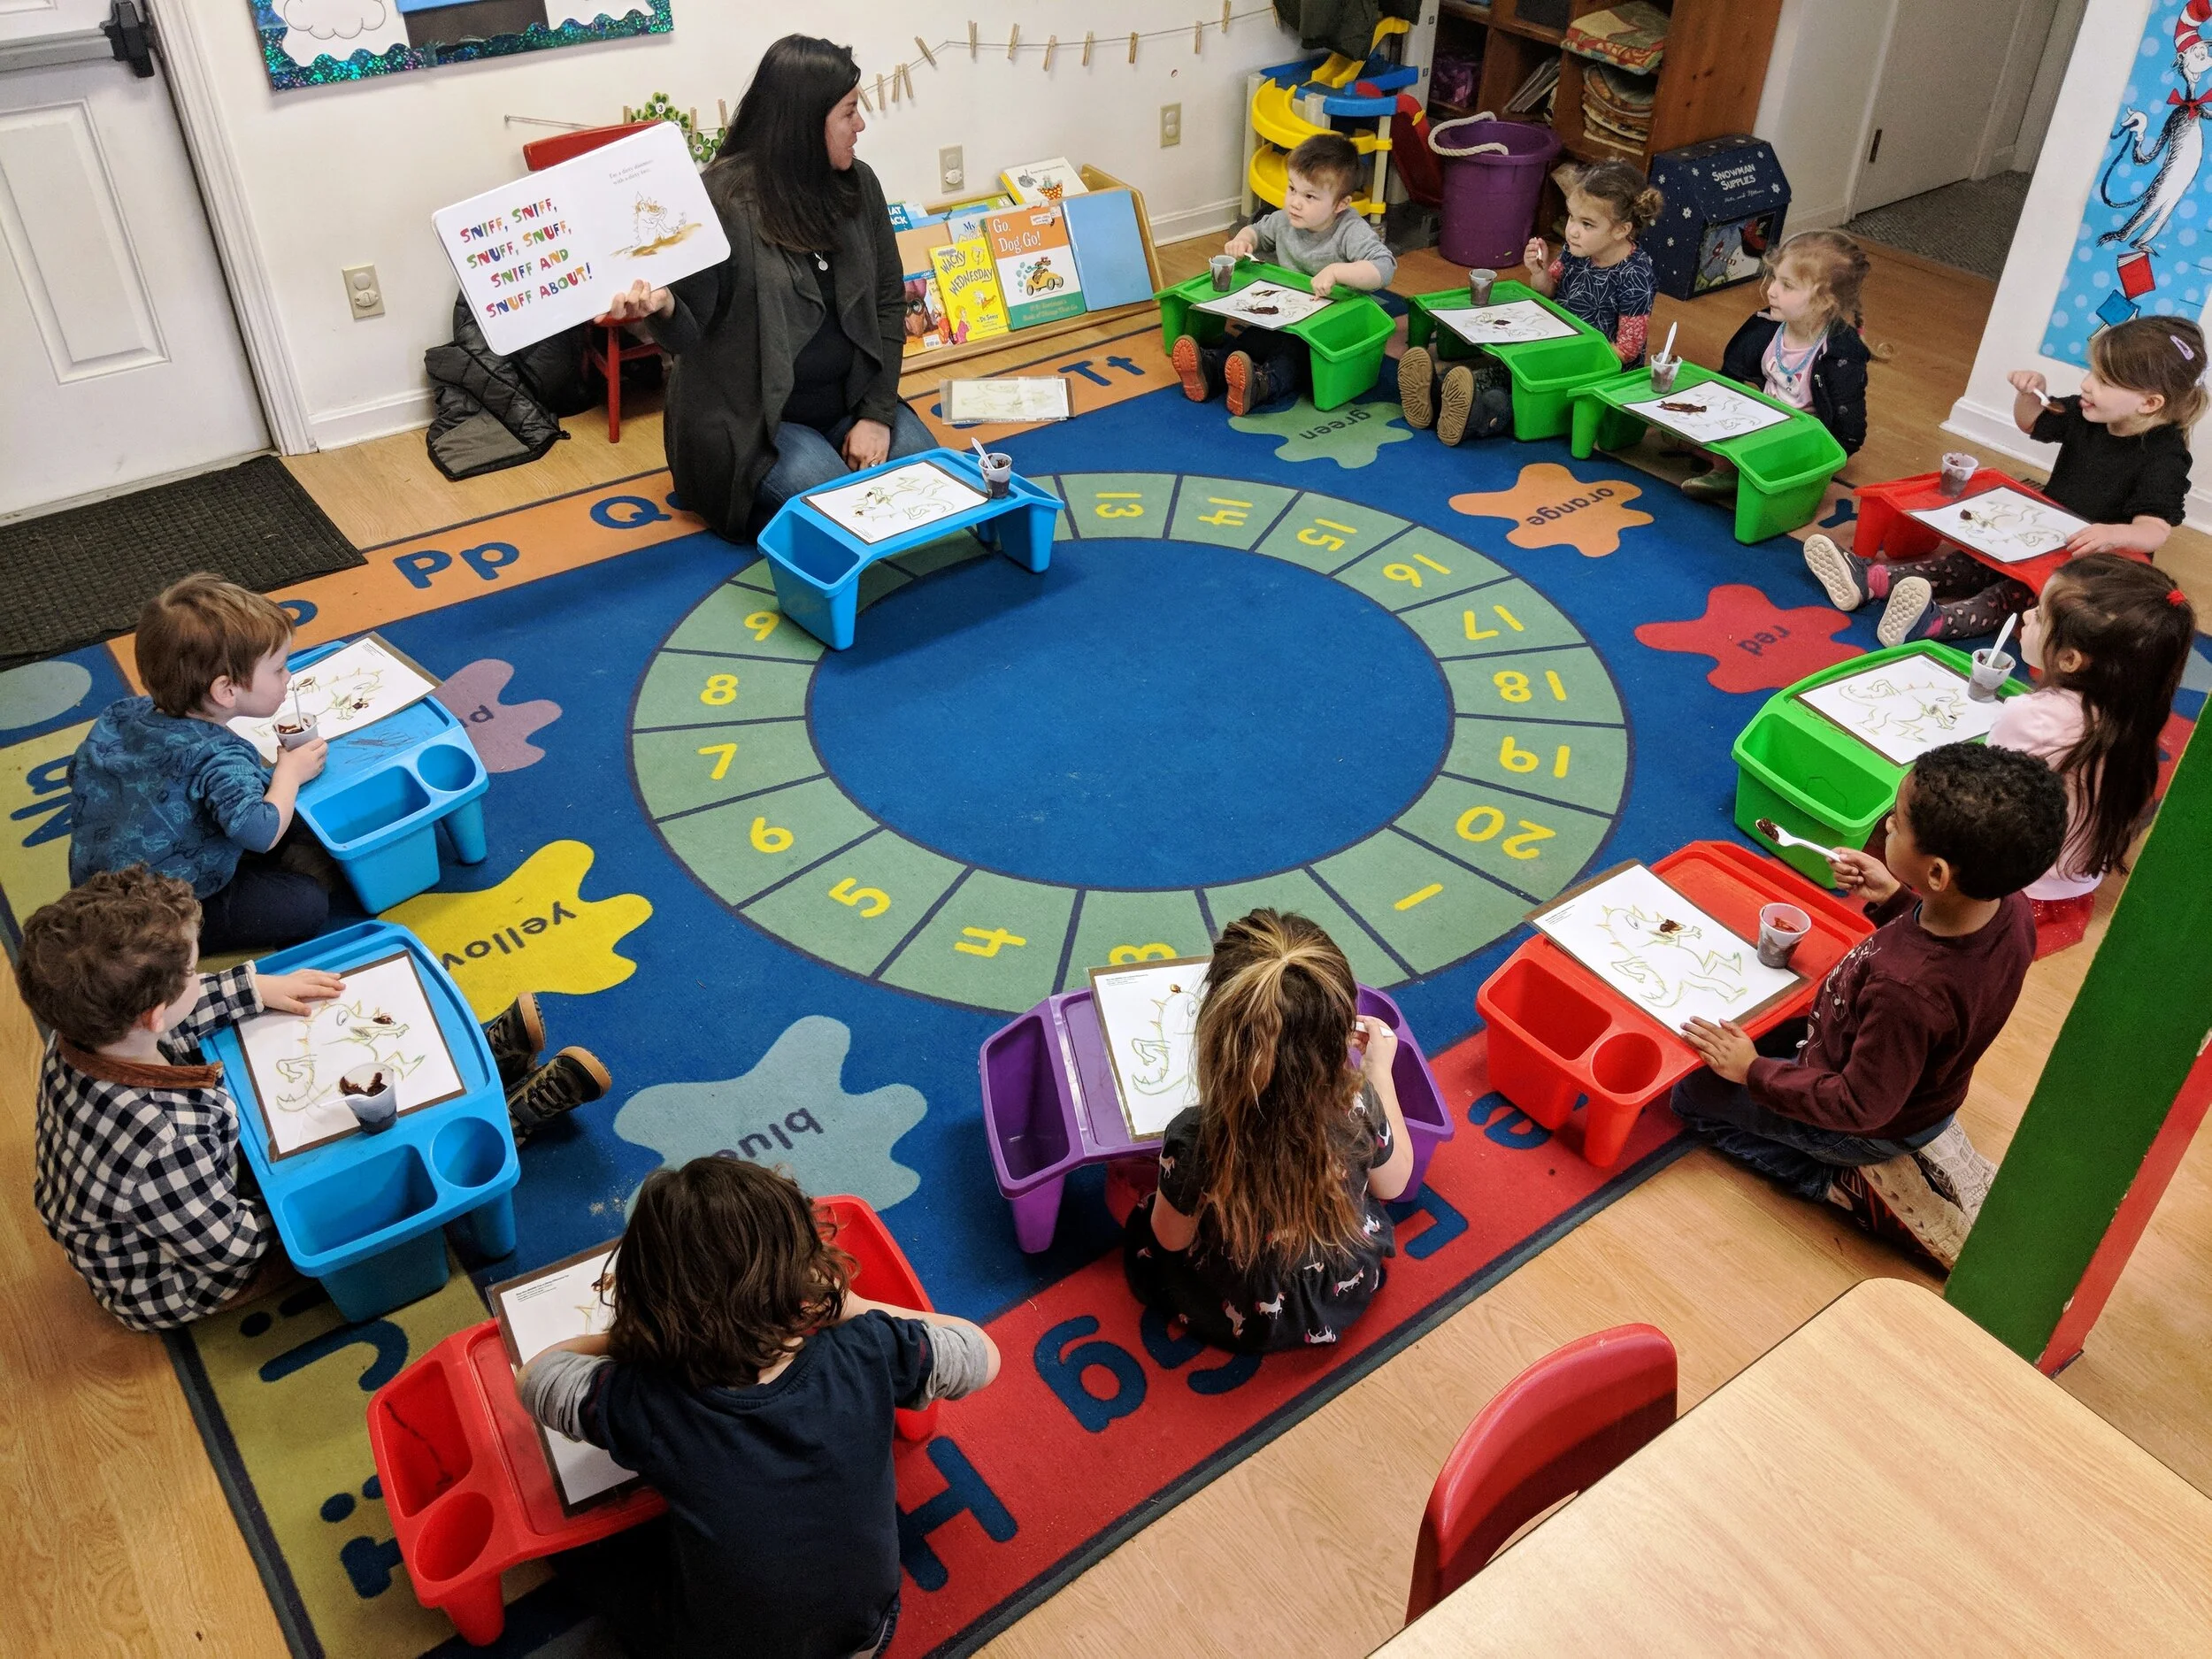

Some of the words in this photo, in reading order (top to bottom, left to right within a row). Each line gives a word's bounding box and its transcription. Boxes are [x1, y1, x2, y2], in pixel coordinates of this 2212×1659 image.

[1711, 164, 1755, 181] SNOWMAN
[1720, 174, 1756, 191] SUPPLIES
[459, 217, 509, 243] SNIFF,
[511, 198, 557, 223] SNIFF,
[466, 242, 519, 269] SNUFF,
[523, 220, 572, 248] SNUFF,
[1023, 230, 1041, 248] Go!
[490, 262, 533, 288] SNIFF
[540, 249, 569, 271] AND
[941, 250, 966, 274] WACKY
[486, 290, 532, 318] SNUFF
[539, 262, 593, 299] ABOUT!
[949, 268, 993, 296] WEDNESDAY
[1057, 356, 1146, 387] Tt
[1299, 409, 1371, 440] green
[1095, 492, 1144, 518] 13
[1198, 496, 1253, 526] 14
[1525, 488, 1615, 526] orange
[1296, 518, 1358, 551] 15
[393, 541, 520, 589] Pp
[1383, 553, 1451, 588] 16
[744, 611, 780, 641] 9
[1463, 605, 1525, 640] 17
[1736, 624, 1791, 657] red
[700, 673, 739, 705] 8
[1493, 670, 1567, 703] 18
[698, 743, 738, 780] 7
[1499, 736, 1571, 779] 19
[750, 817, 794, 854] 6
[1455, 805, 1557, 860] 20
[828, 877, 891, 918] 5
[1394, 883, 1444, 911] 1
[954, 926, 1027, 958] 4
